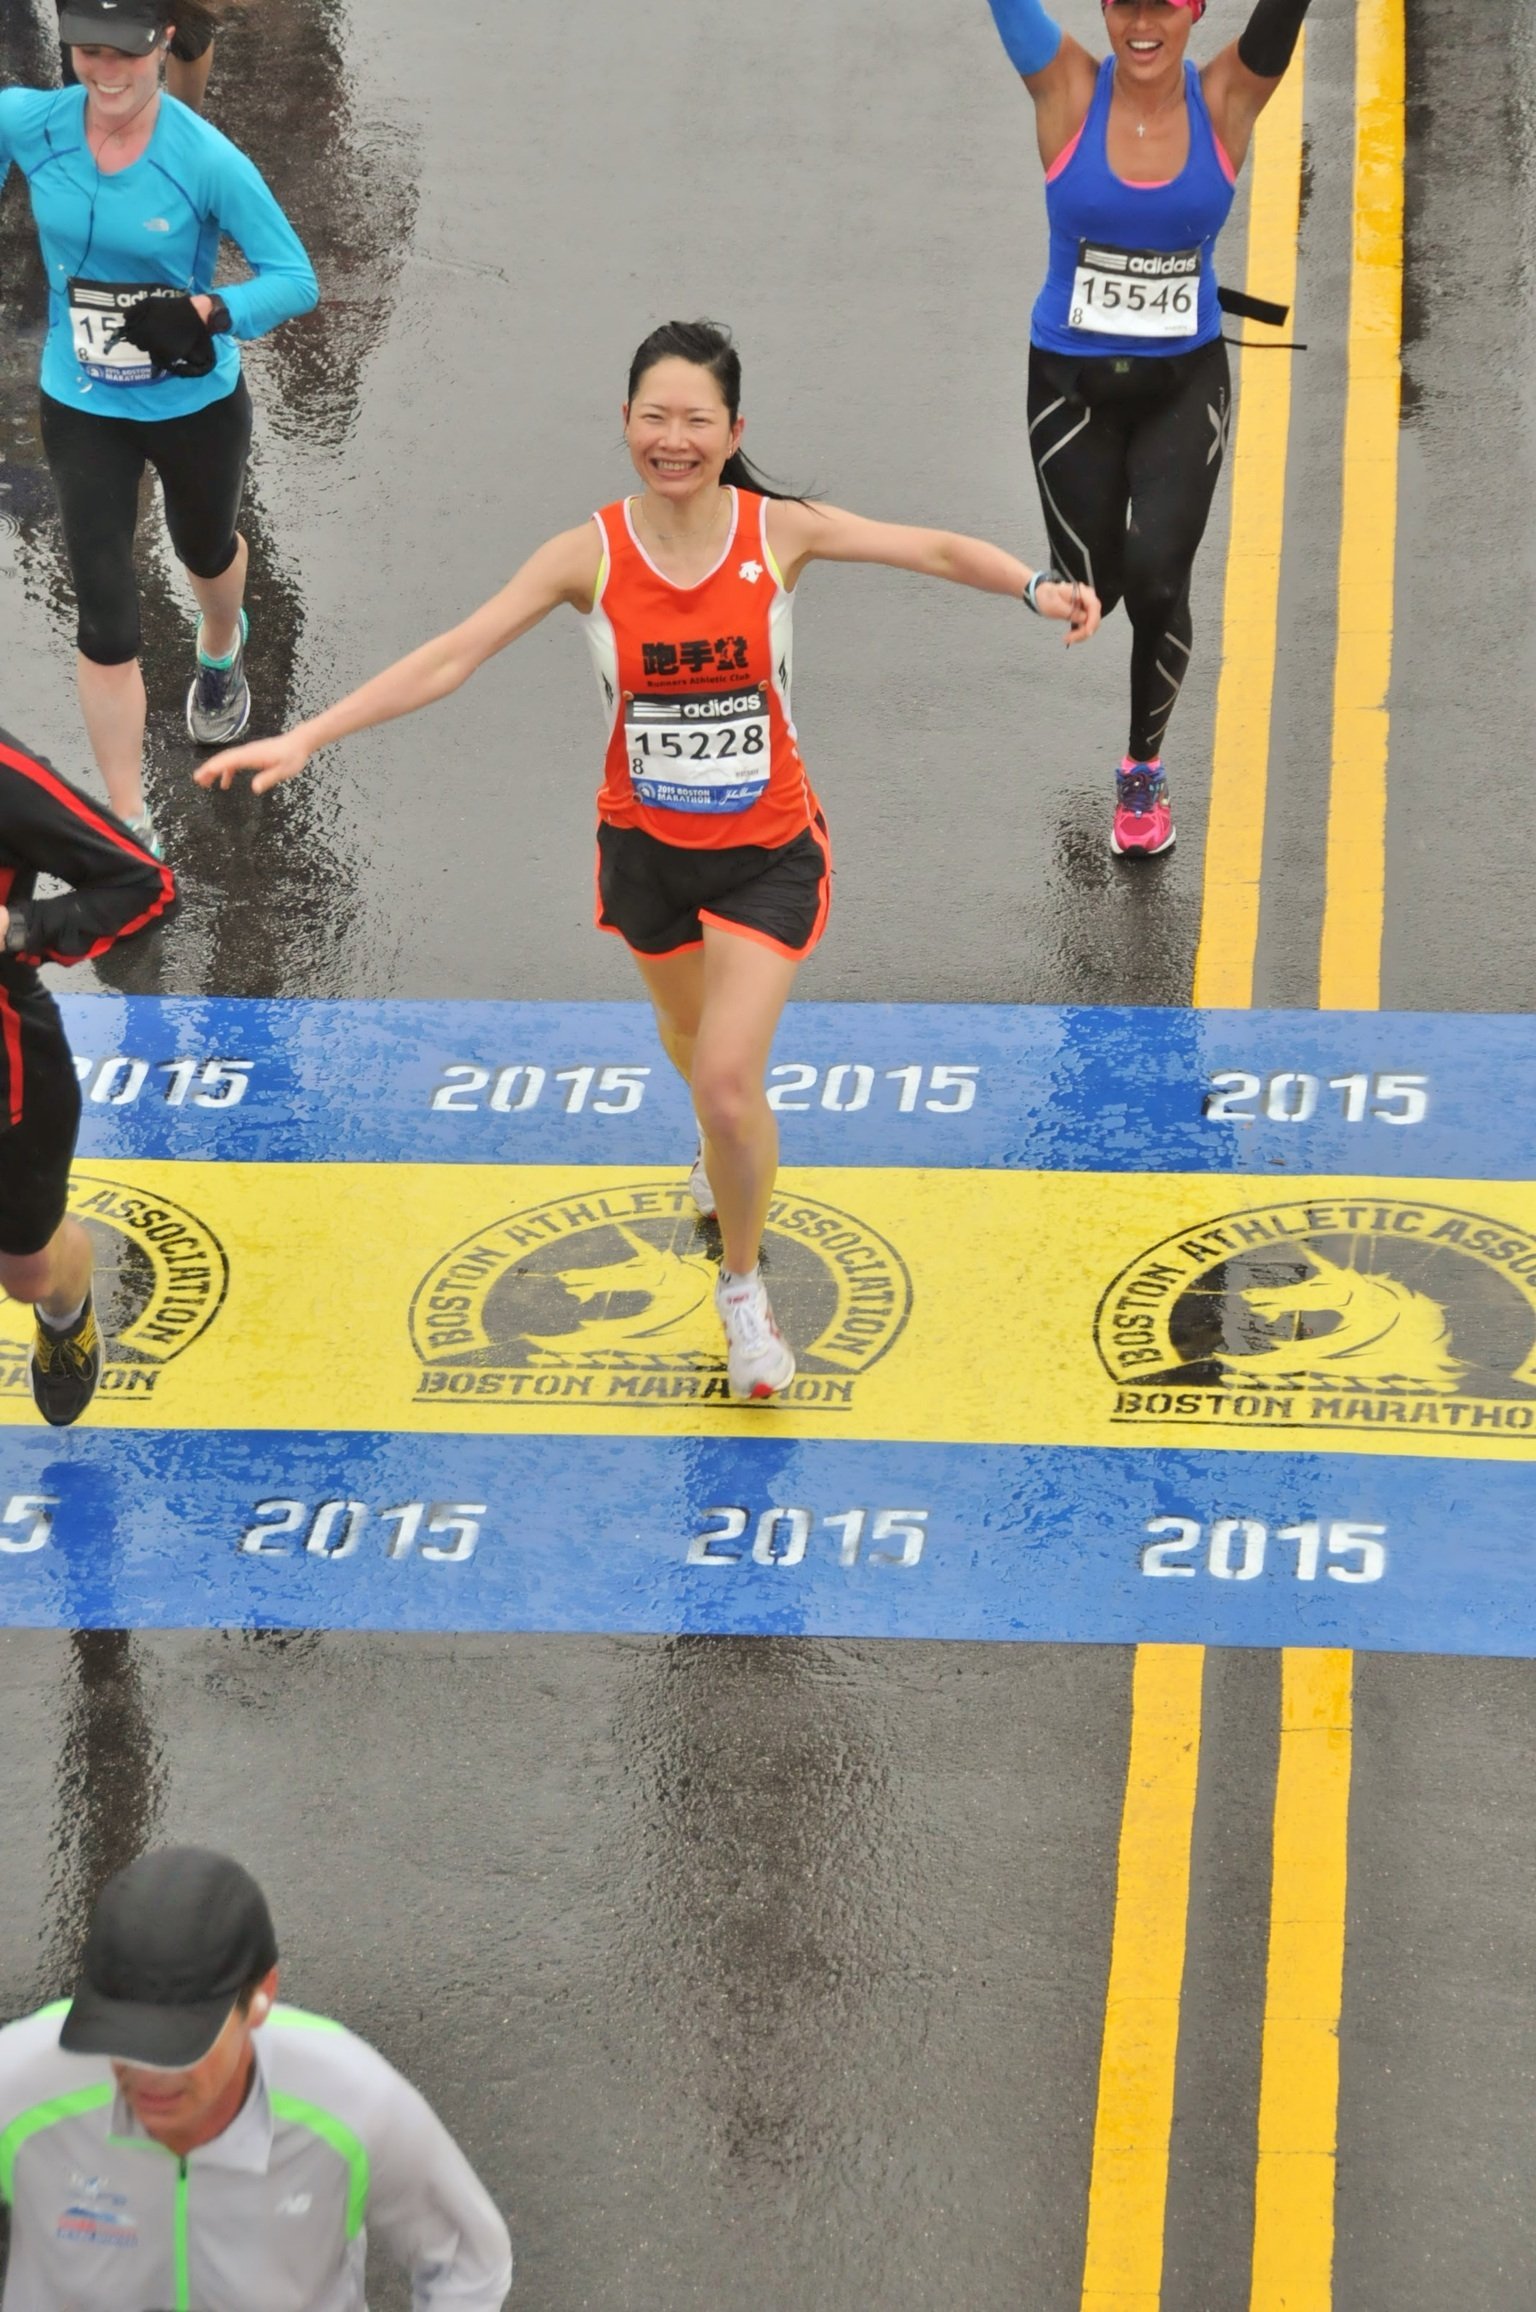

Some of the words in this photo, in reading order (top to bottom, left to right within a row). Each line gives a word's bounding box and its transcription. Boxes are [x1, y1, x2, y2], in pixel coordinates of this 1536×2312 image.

[1129, 255, 1197, 274] adidas
[1083, 277, 1192, 314] 15546
[1072, 307, 1083, 325] 8
[78, 348, 88, 361] 8
[690, 675, 726, 685] Athletic
[729, 673, 750, 682] Club
[684, 693, 761, 718] adidas
[635, 724, 764, 760] 15228
[632, 758, 644, 775] 8
[657, 784, 675, 794] 2015
[677, 787, 710, 797] BOSTON
[657, 793, 711, 804] MARATHON
[74, 1056, 255, 1109] 015
[431, 1064, 652, 1114] 2015
[766, 1063, 981, 1113] 2015
[1206, 1071, 1429, 1125] 2015
[425, 1245, 505, 1349] BOSTON
[503, 1188, 692, 1247] ATHLET
[1112, 1261, 1186, 1369] BOSTON
[1178, 1205, 1426, 1264] ATHLETIC
[416, 1372, 591, 1396] BOSTON
[609, 1373, 855, 1402] MARAON
[1113, 1391, 1293, 1419] BOSTON
[1309, 1394, 1534, 1430] MARATHO
[239, 1499, 487, 1562] 2015
[685, 1505, 929, 1567] 2015
[1141, 1515, 1387, 1584] 2015
